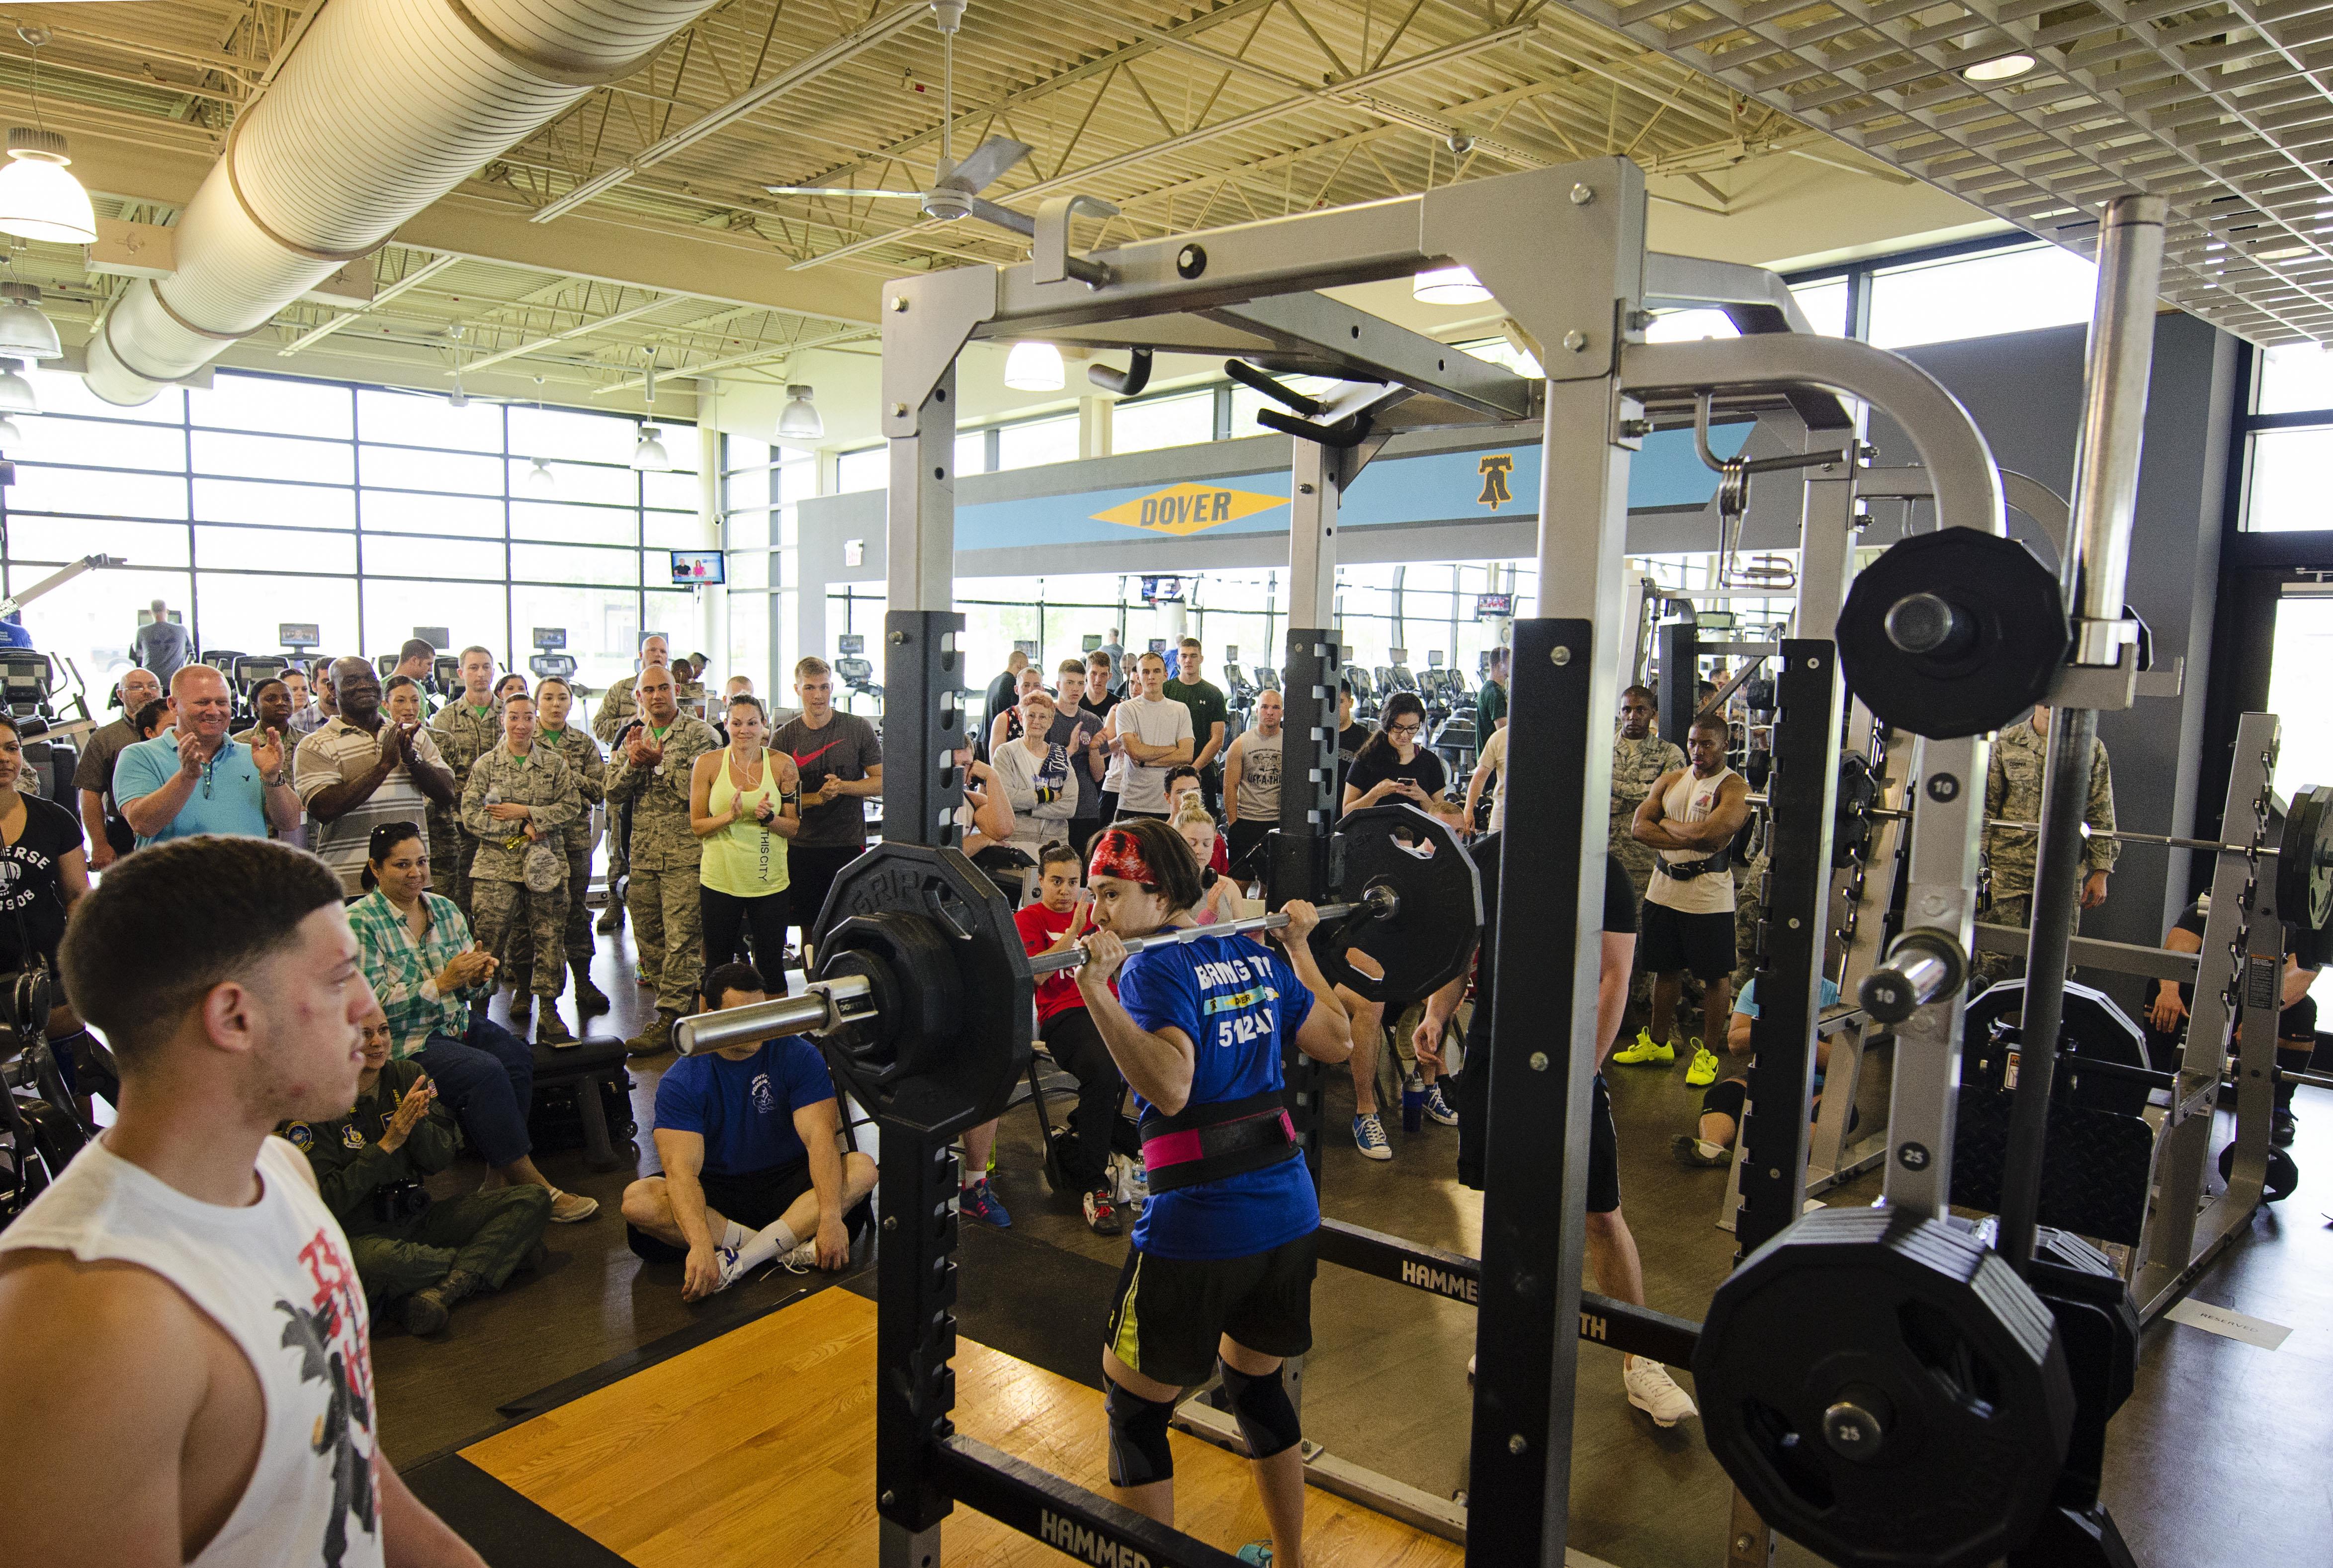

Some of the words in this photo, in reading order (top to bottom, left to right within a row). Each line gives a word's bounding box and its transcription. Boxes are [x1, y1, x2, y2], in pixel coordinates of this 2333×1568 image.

[1140, 492, 1231, 526] DOVER
[1934, 781, 1953, 795] 10
[761, 830, 770, 854] THIS
[0, 845, 50, 870] ERSE
[758, 856, 769, 881] CITY
[1194, 959, 1251, 990] BRING
[1874, 987, 1895, 1004] 10
[392, 1089, 402, 1106] ikon
[1904, 1148, 1923, 1163] 25
[1402, 1260, 1479, 1303] HAMME
[2200, 1312, 2259, 1332] RESERVED
[1839, 1425, 1860, 1441] 25
